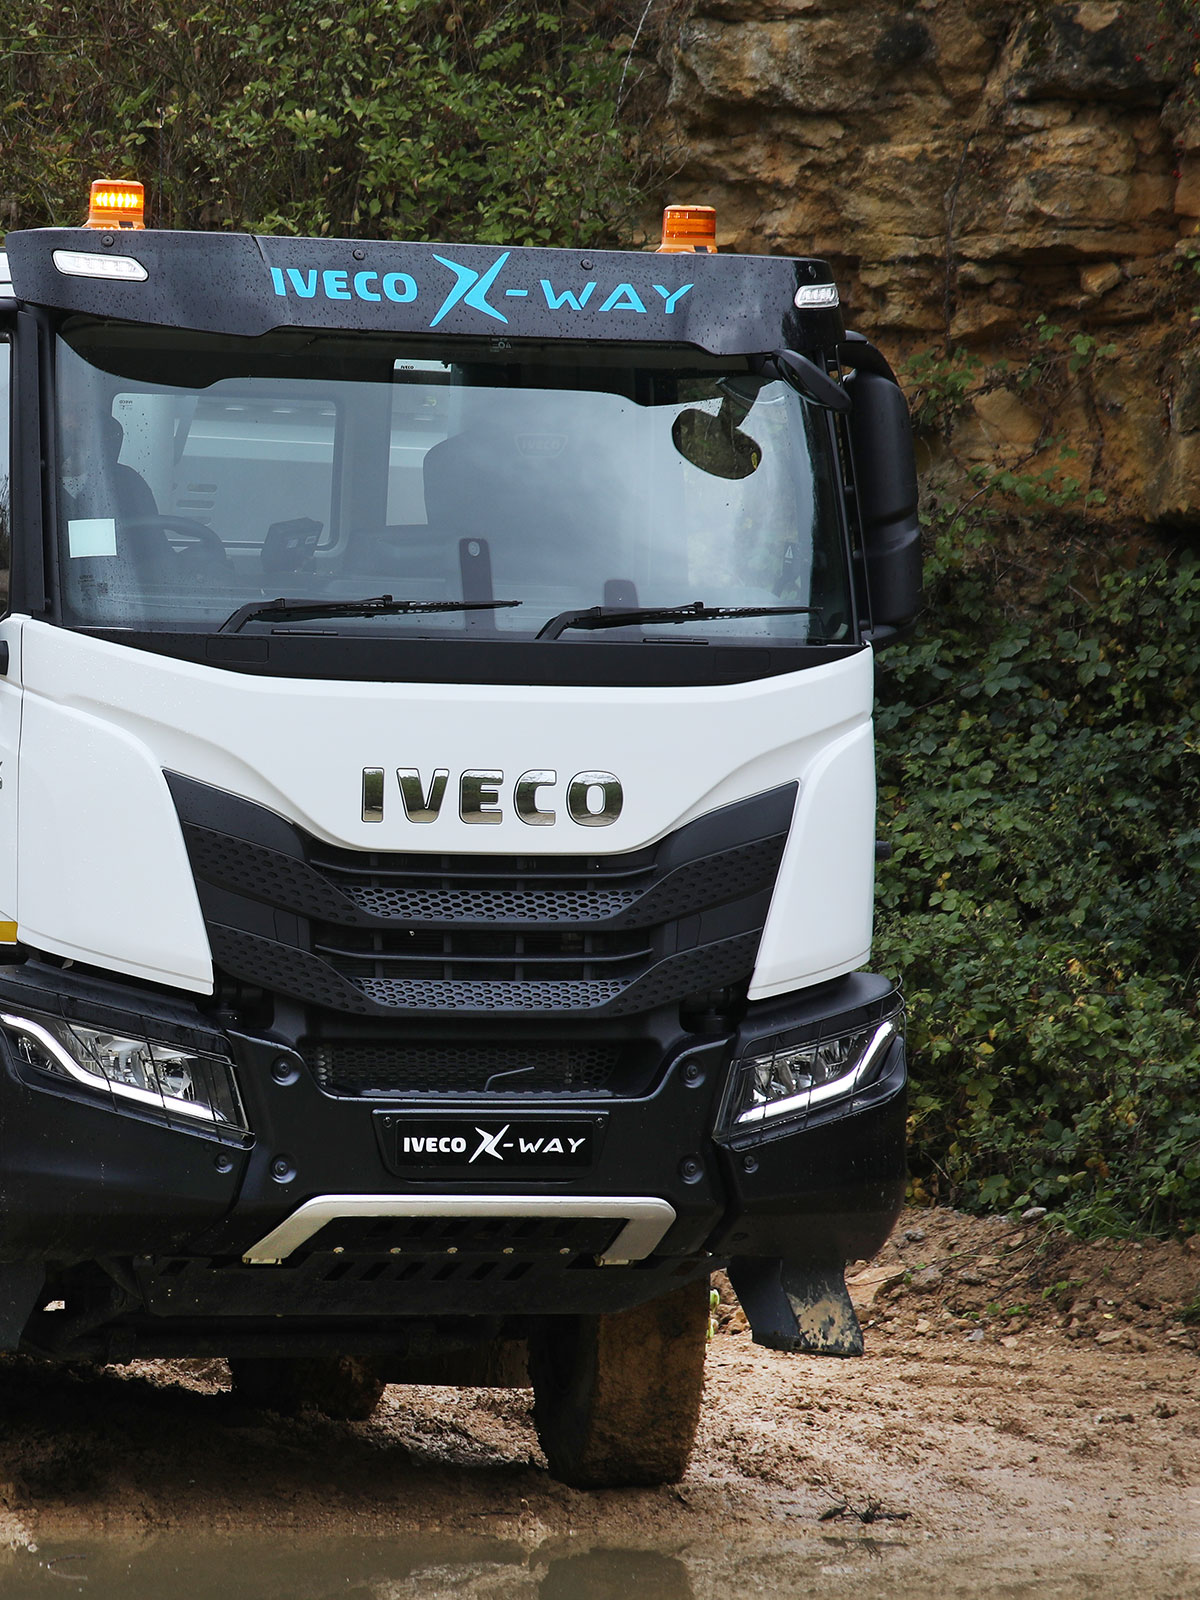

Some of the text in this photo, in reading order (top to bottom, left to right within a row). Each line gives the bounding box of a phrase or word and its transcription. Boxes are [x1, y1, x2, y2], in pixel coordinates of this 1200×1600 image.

[270, 267, 418, 303] IVECO
[360, 766, 624, 827] IVECO
[403, 1137, 467, 1153] IVECO
